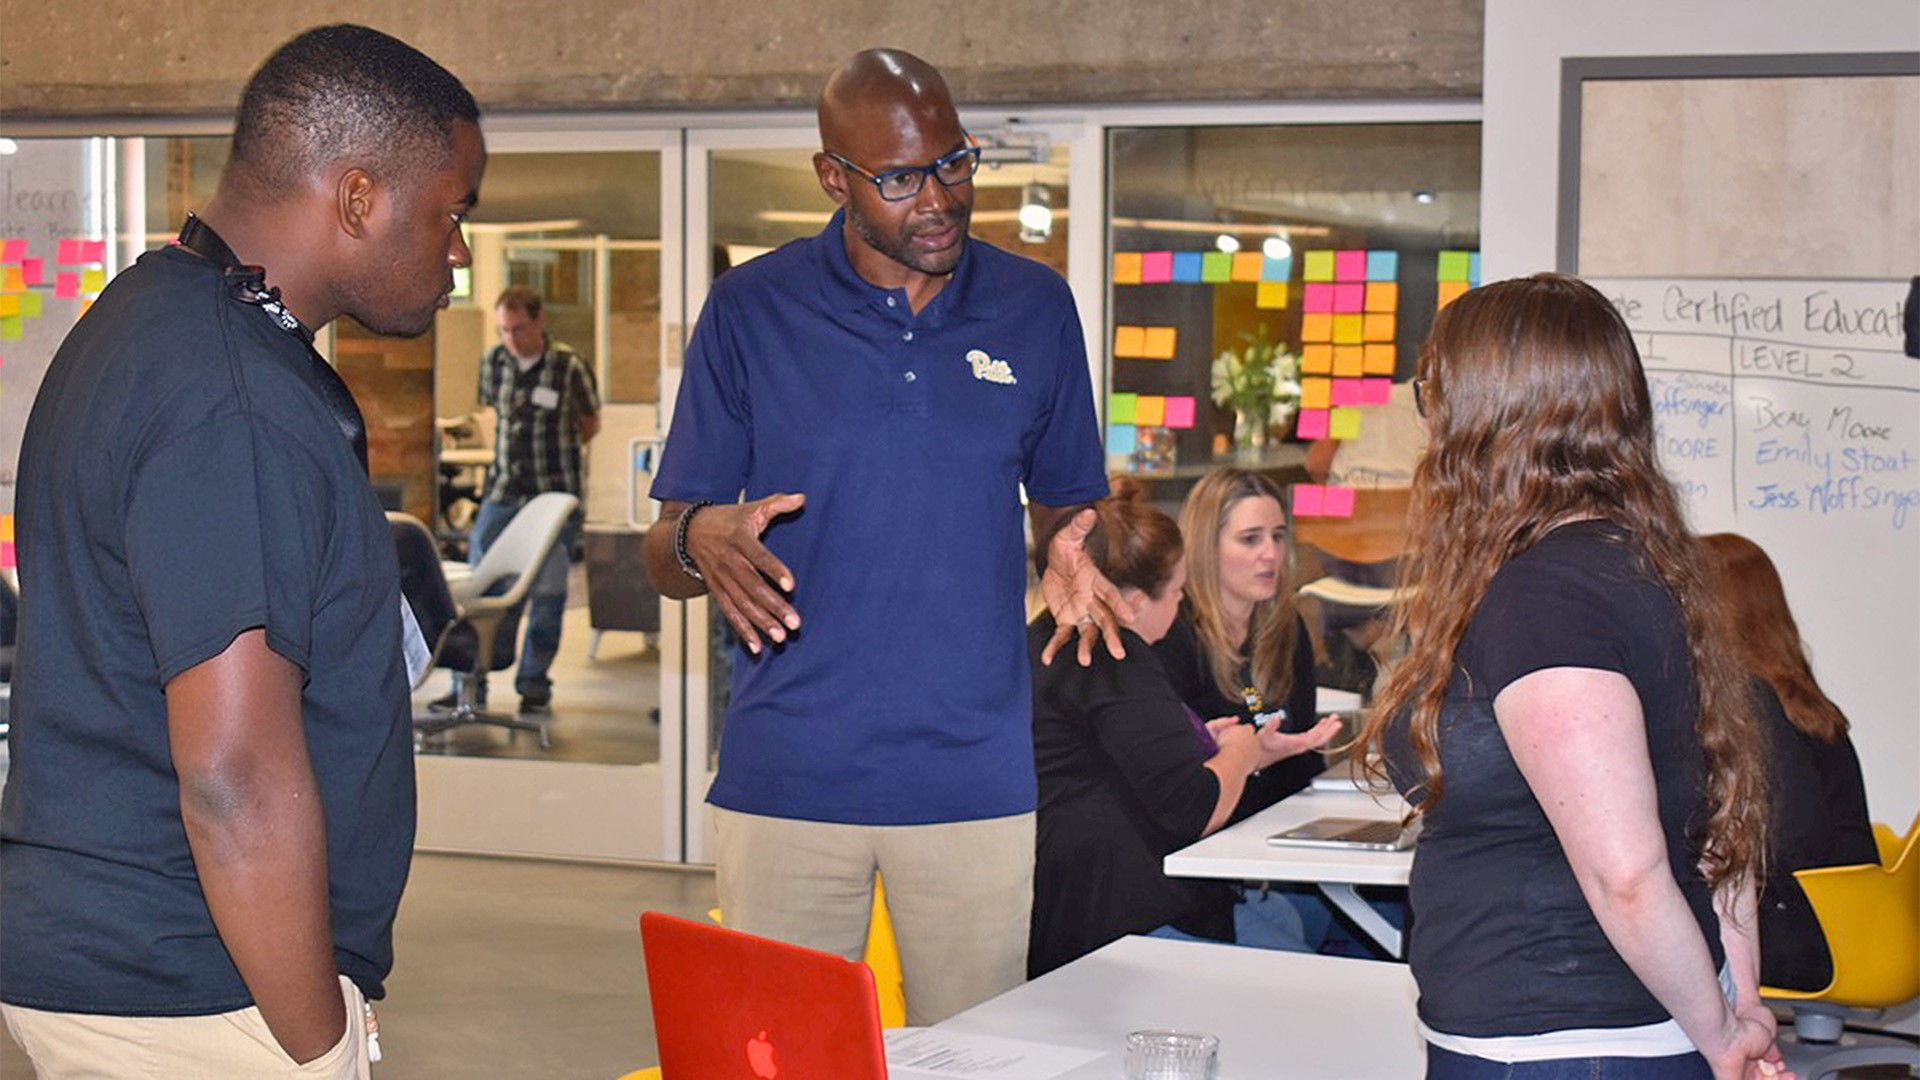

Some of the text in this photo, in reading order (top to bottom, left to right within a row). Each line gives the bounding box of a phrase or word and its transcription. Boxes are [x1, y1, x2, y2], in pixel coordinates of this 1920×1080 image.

[1662, 284, 1783, 334] Certified
[1803, 289, 1904, 338] Educat
[1739, 345, 1864, 380] LEVEL 2
[1650, 383, 1731, 429] offsinger
[1756, 431, 1831, 478] Emily
